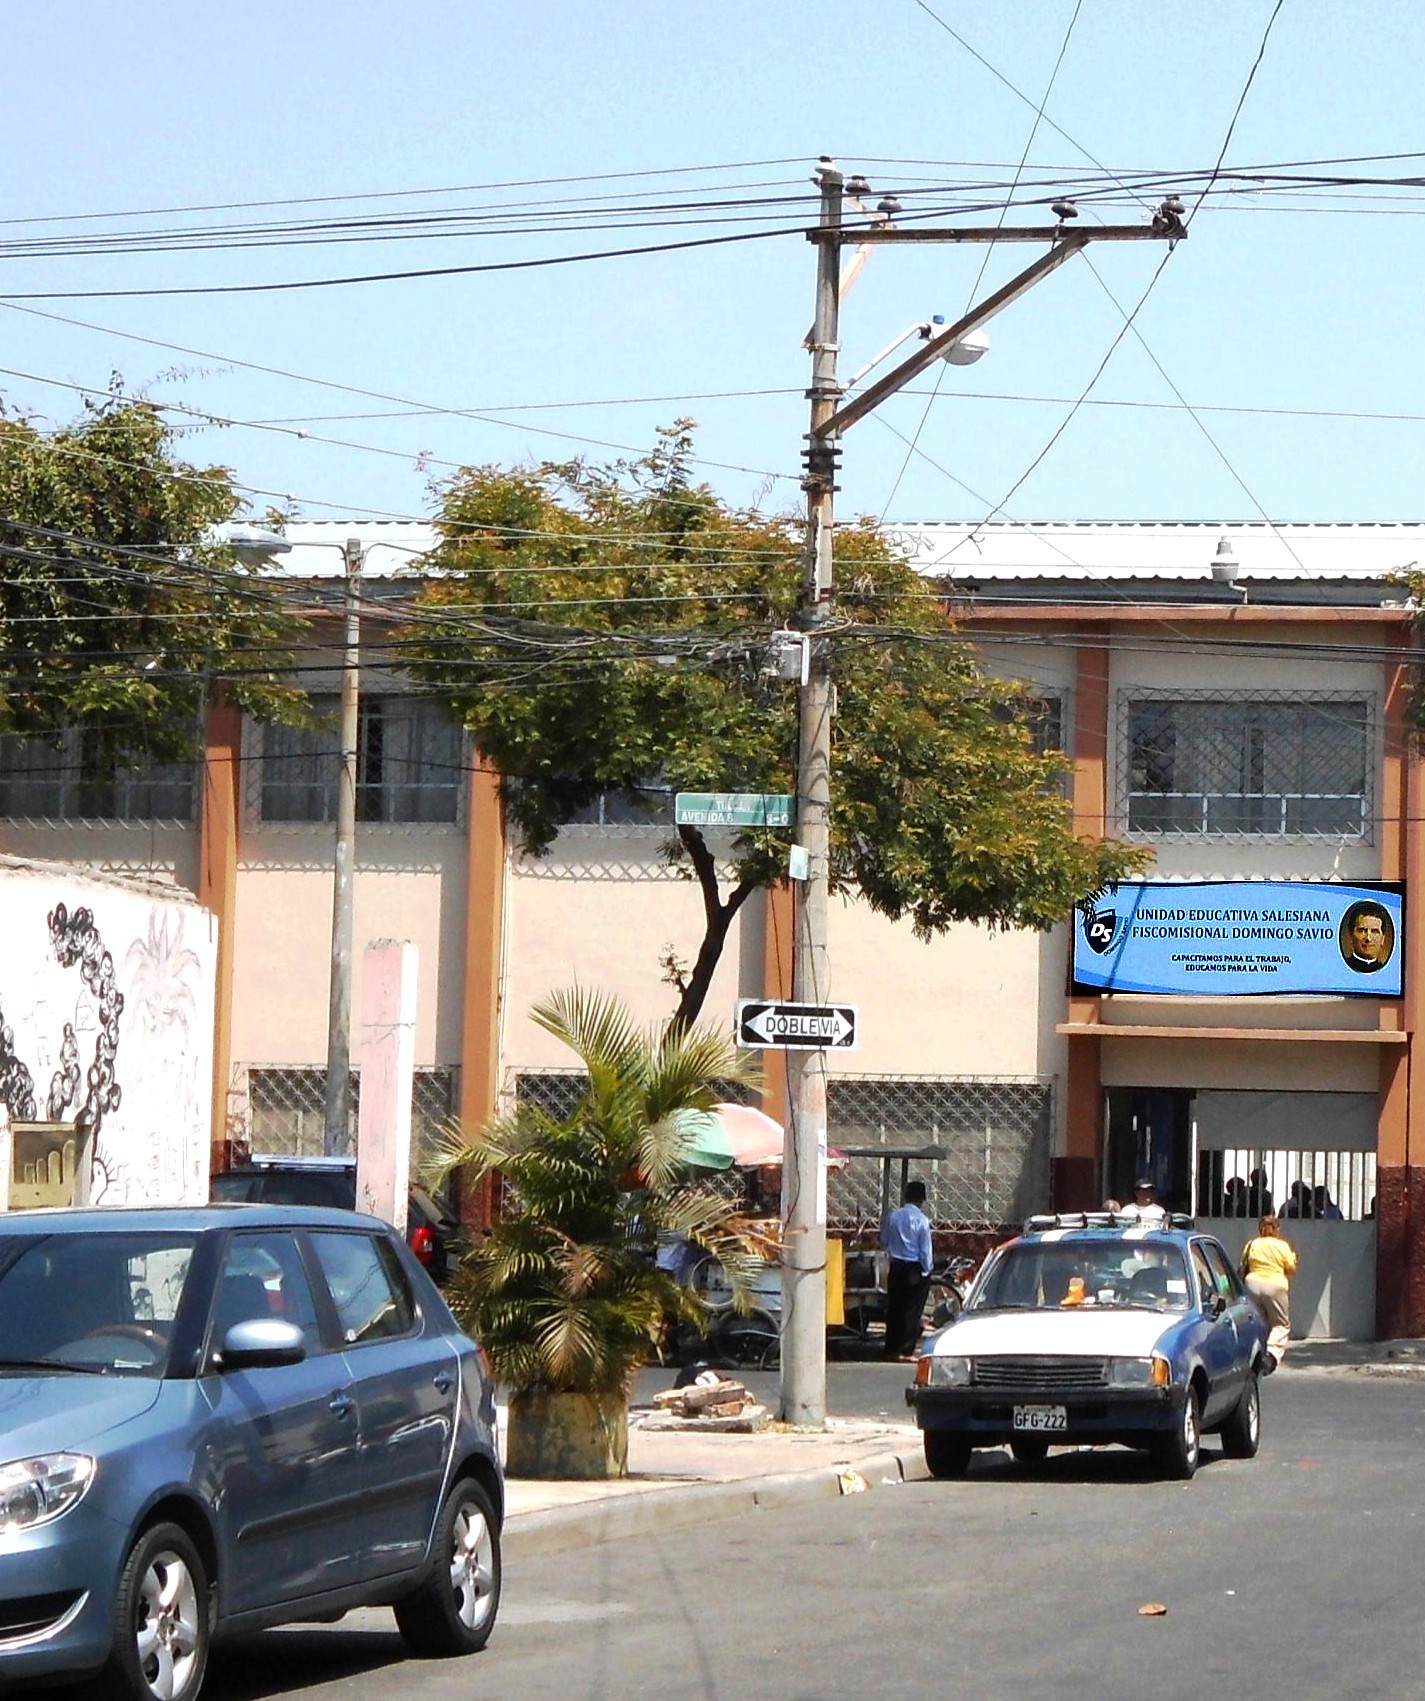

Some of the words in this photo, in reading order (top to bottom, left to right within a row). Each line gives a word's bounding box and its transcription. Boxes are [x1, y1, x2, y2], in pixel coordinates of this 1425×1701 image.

[681, 812, 724, 823] AVENIDA
[1136, 909, 1186, 921] UNIDAD
[1188, 909, 1259, 921] EDUCATIVA
[1261, 909, 1330, 922] SALESIANA
[1090, 923, 1113, 943] DS
[1132, 926, 1229, 939] FISCOMISIONAL
[1232, 927, 1294, 940] DOMINGO
[1296, 928, 1334, 940] SAVIO
[1171, 954, 1222, 962] CAPACITAMOS
[1224, 955, 1244, 963] PARA
[1245, 955, 1255, 963] EL
[1185, 964, 1226, 972] EDUCAMOS
[1227, 964, 1247, 973] PARA
[1248, 965, 1259, 973] LA
[1260, 964, 1278, 973] VIDA
[765, 1016, 818, 1035] DOBLE
[820, 1018, 841, 1035] VIA
[1014, 1412, 1066, 1429] GFG-222
